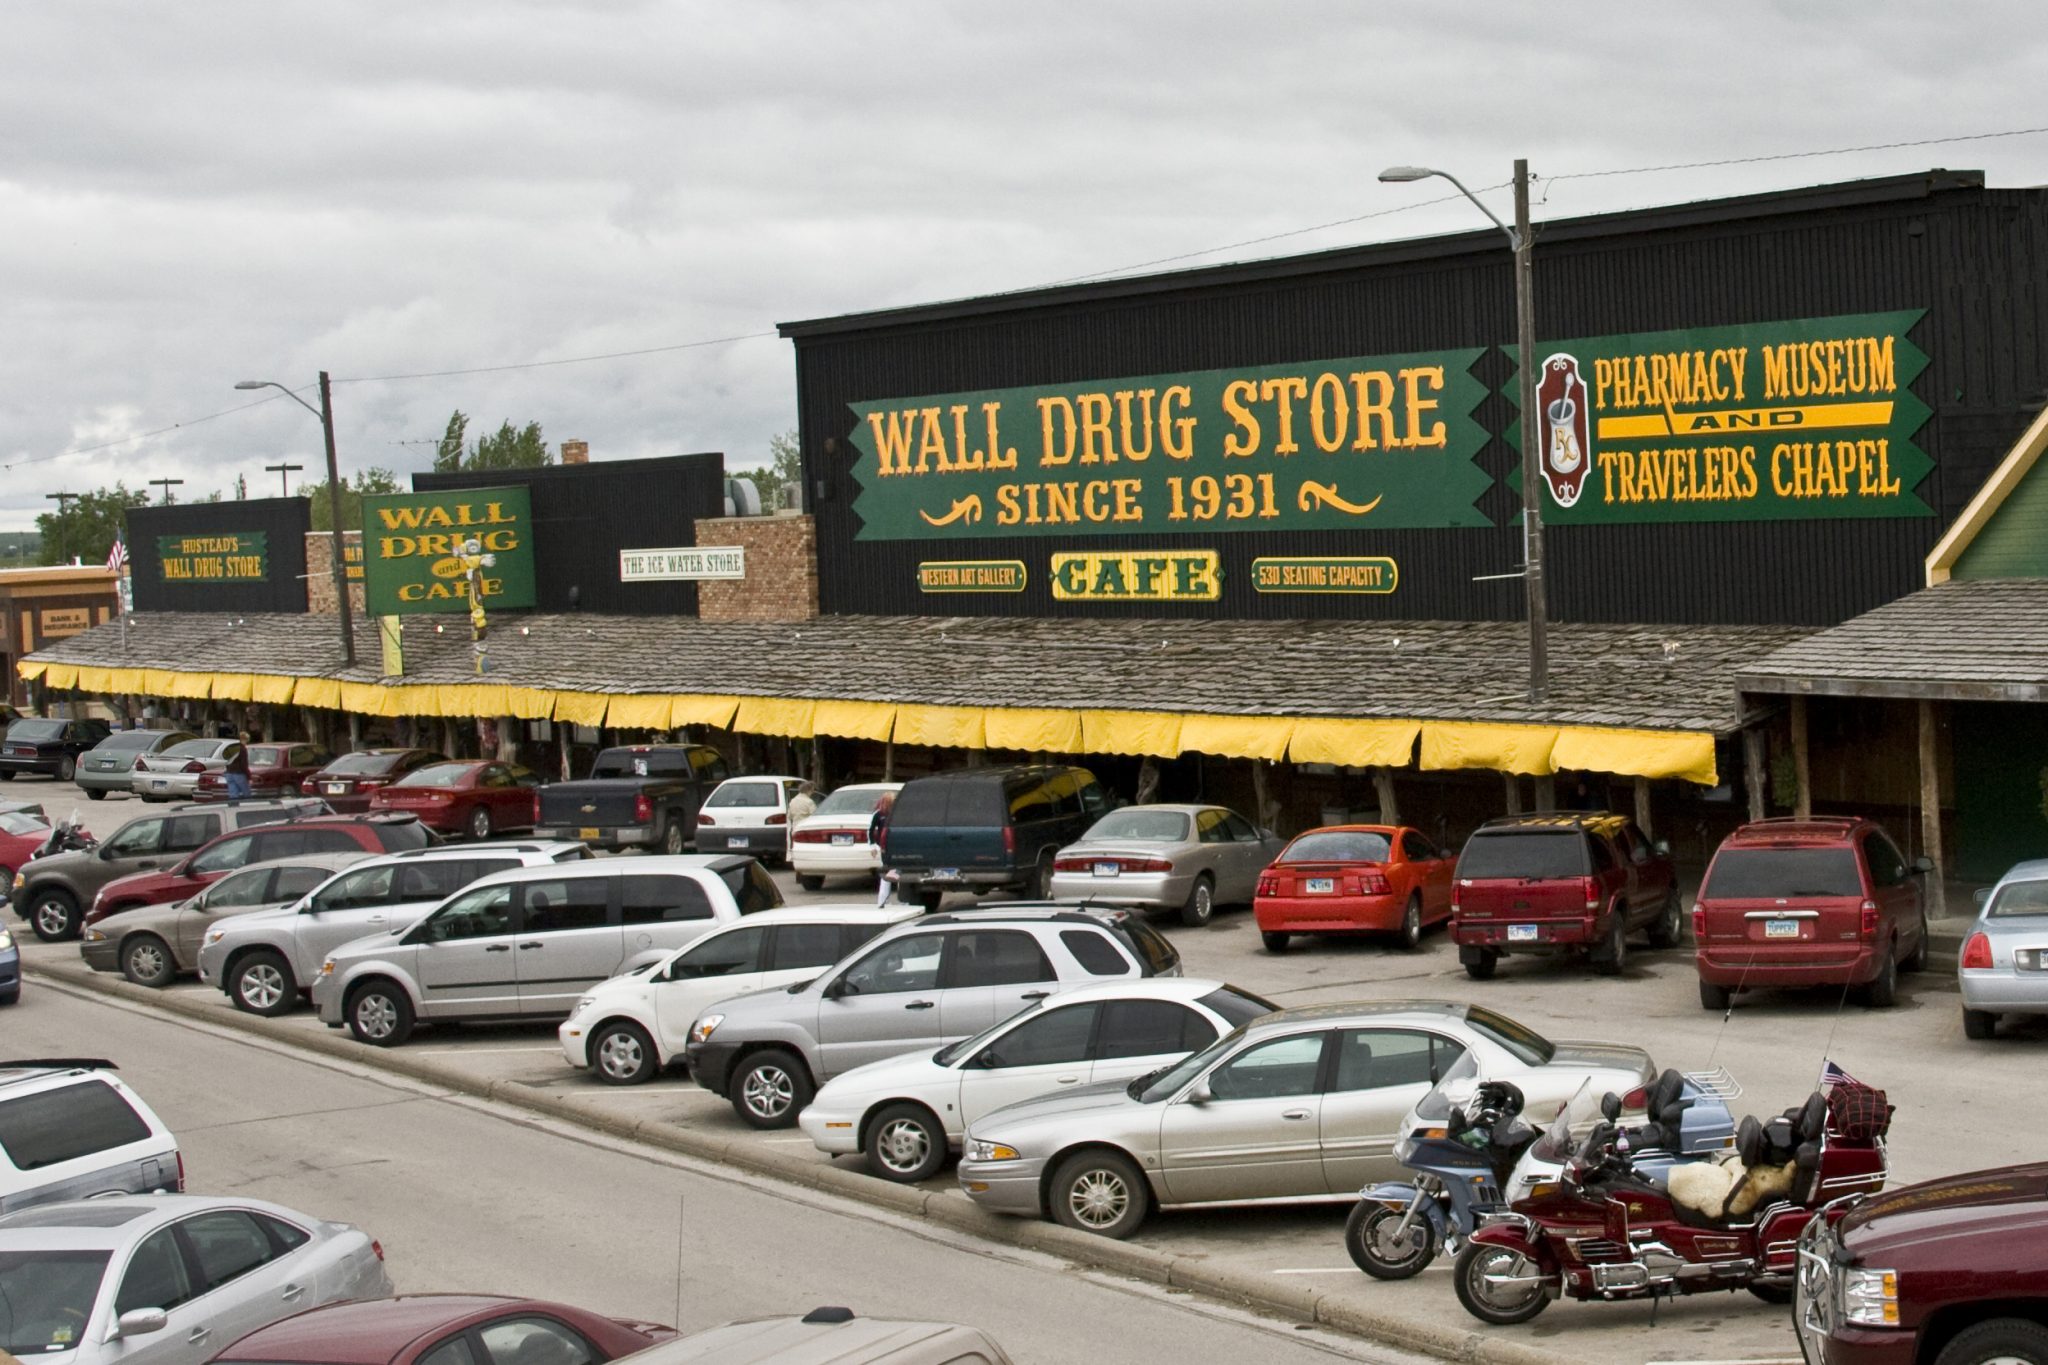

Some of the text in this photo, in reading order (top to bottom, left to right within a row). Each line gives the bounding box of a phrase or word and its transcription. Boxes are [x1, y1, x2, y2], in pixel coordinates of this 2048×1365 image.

[1594, 334, 1897, 408] PHARMACY MUSEUM
[867, 364, 1447, 477] WALL DRUG STORE
[1689, 410, 1804, 430] AND
[1597, 437, 1900, 504] TRAVELERS CHAPEL
[996, 472, 1280, 526] SINCE 1931
[377, 501, 517, 531] WALL
[181, 537, 239, 553] HUSTEAD'S
[378, 529, 519, 559] DRUG
[163, 555, 262, 578] WALL DRUG STORE
[437, 560, 462, 574] and
[623, 553, 741, 574] THE ICE WATER STORE
[921, 567, 1017, 586] WESTERN ART GALLERY
[1055, 557, 1210, 596] CAFE
[1259, 565, 1383, 586] 530 SEATING CAPACITY
[398, 578, 504, 601] CAFE
[50, 615, 73, 623] BANK
